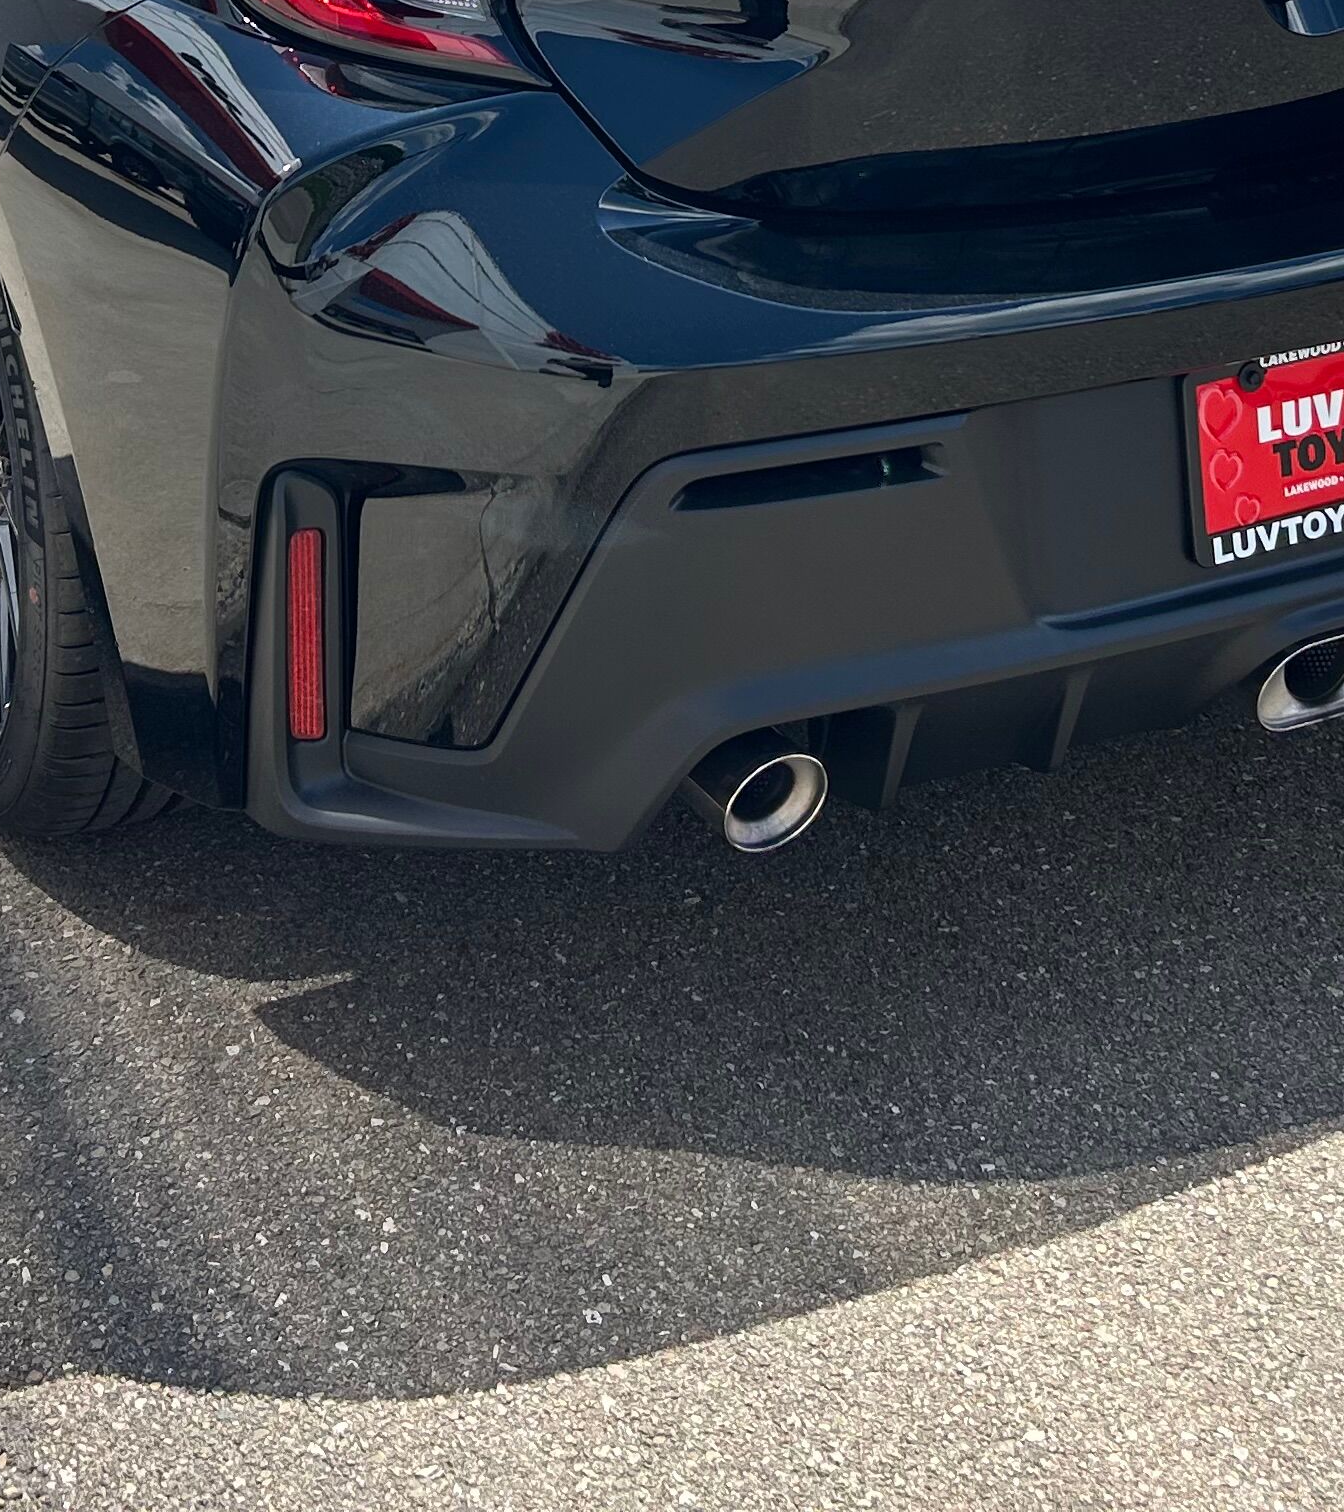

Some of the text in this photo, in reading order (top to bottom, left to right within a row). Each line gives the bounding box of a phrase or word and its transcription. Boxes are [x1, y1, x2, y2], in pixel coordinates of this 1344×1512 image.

[1259, 341, 1342, 368] LAKEWOOD
[1256, 389, 1344, 443] LUV
[1283, 476, 1339, 498] LAKEWOOD
